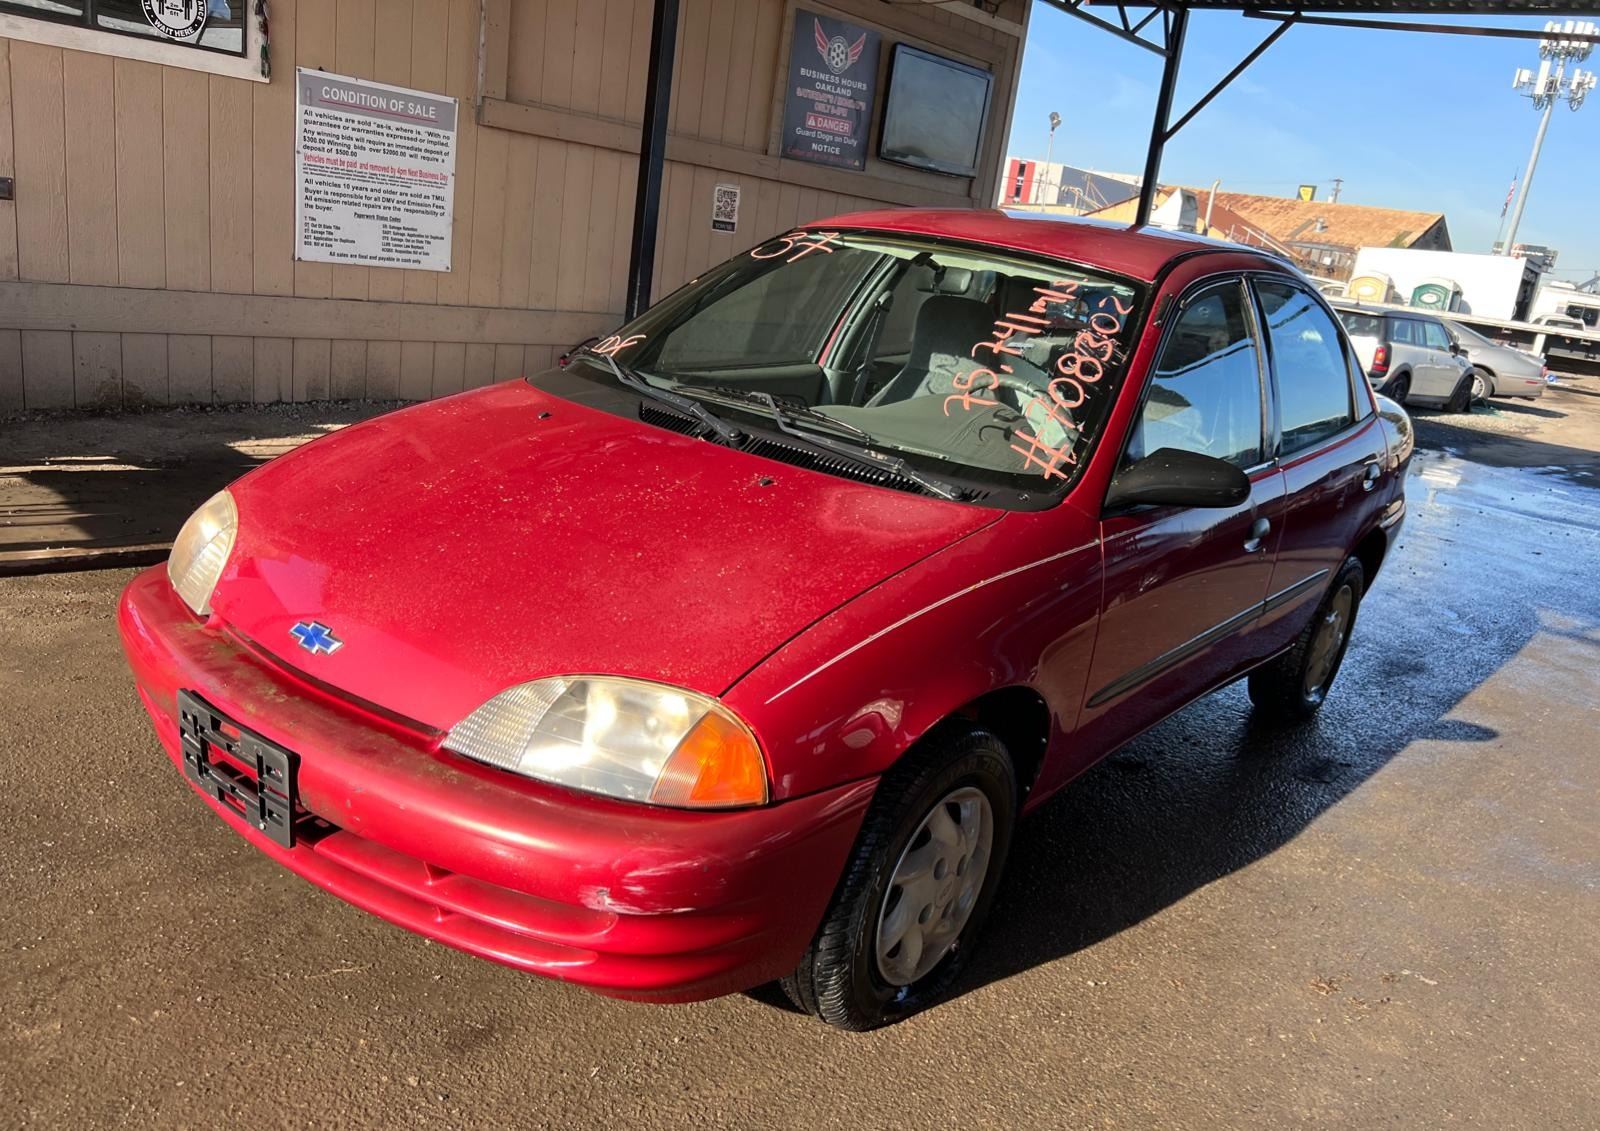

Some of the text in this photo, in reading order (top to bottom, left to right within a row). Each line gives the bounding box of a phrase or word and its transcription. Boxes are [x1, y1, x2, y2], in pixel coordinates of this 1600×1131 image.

[154, 18, 195, 37] WAIT HERE
[800, 67, 867, 90] BUSINESS HOURS
[815, 83, 852, 97] OAKLAND
[322, 86, 436, 119] CONDITION OF SALE
[304, 118, 341, 131] guarantees
[352, 125, 384, 137] warranties
[386, 132, 417, 144] expressed
[315, 112, 343, 122] vehicles
[357, 118, 371, 127] sold
[395, 126, 413, 134] where
[817, 119, 850, 132] DANGER
[303, 128, 315, 136] Any
[317, 131, 340, 142] winning
[342, 133, 354, 142] bids
[355, 136, 365, 144] will
[366, 138, 385, 148] require
[395, 142, 422, 152] immediate
[424, 147, 443, 157] deposit
[796, 127, 816, 138] Guard
[817, 131, 832, 142] Dogs
[844, 135, 857, 146] Duty
[303, 135, 326, 145] $300.00
[327, 138, 351, 150] Winning
[353, 143, 366, 151] bids
[383, 147, 406, 157] $2000.00
[420, 154, 439, 163] require
[303, 144, 325, 153] deposit
[335, 148, 357, 158] $500.00
[811, 143, 841, 154] NOTICE
[304, 152, 324, 163] Vehicles
[326, 156, 337, 165] must
[339, 157, 346, 166] be
[347, 158, 357, 169] paid
[359, 160, 368, 169] and
[369, 162, 389, 172] removed
[390, 164, 396, 174] by
[397, 166, 407, 176] 4pm
[408, 166, 418, 176] Next
[419, 169, 439, 179] Business
[440, 173, 448, 182] Day
[304, 187, 322, 196] Buyer
[330, 190, 363, 201] responsible
[408, 200, 431, 208] Emission
[315, 179, 341, 188] vehicles
[352, 185, 368, 195] years
[383, 187, 398, 195] older
[410, 190, 422, 198] sold
[314, 197, 340, 205] emission
[342, 199, 361, 208] related
[362, 202, 381, 210] repairs
[404, 206, 438, 217] responsibility
